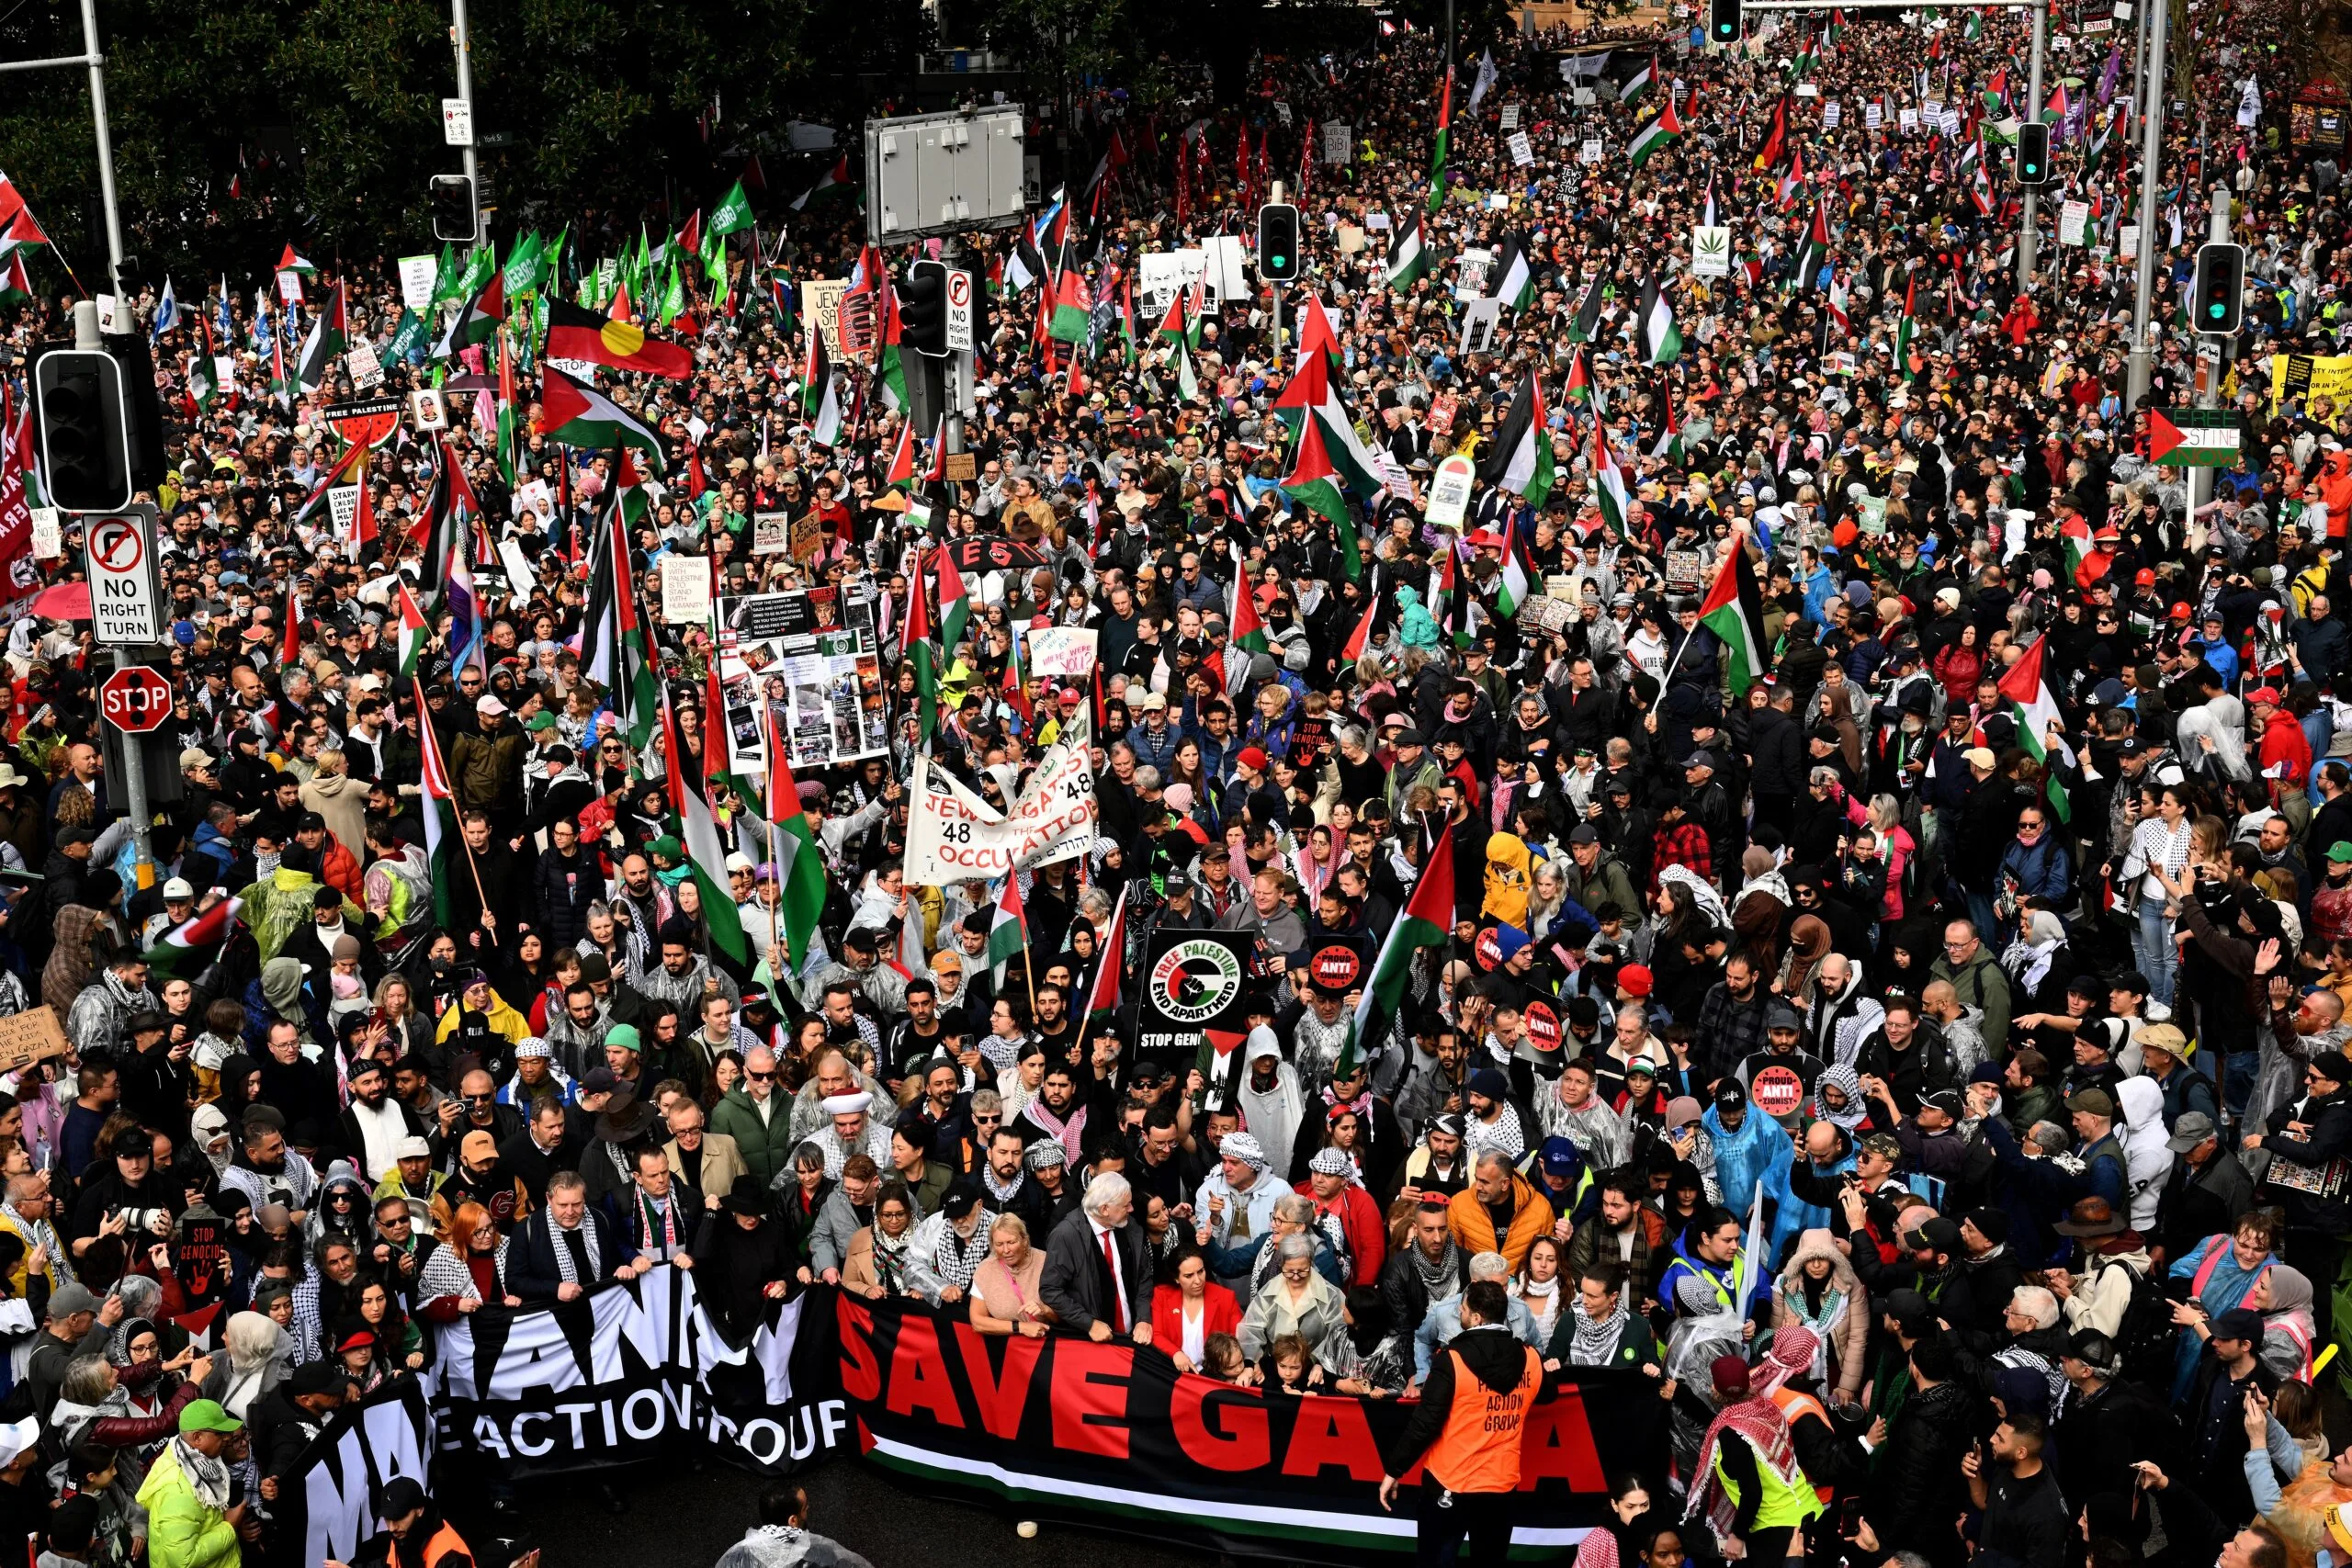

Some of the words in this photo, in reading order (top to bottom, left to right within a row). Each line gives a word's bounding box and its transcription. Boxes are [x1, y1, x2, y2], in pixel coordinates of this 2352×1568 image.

[483, 134, 496, 143] York
[1562, 167, 1582, 179] JEWS
[1561, 176, 1577, 186] SAY
[1558, 185, 1579, 194] STOP
[952, 309, 967, 322] NO
[948, 324, 969, 335] RIGHT
[950, 335, 969, 346] TURN
[361, 369, 375, 379] LAND
[555, 361, 587, 373] STOP
[362, 377, 379, 387] BACK
[325, 409, 348, 419] FREE
[351, 402, 398, 415] PALESTINE
[2173, 409, 2236, 428] FREE
[2176, 447, 2239, 465] NOW
[37, 526, 56, 537] NOT
[795, 515, 814, 537] JEWS
[103, 578, 137, 599] NO
[99, 603, 147, 617] RIGHT
[104, 621, 148, 636] TURN
[1032, 628, 1056, 651] HISTORY
[1042, 651, 1065, 666] WHERE
[1069, 644, 1092, 656] WERE
[1060, 651, 1092, 673] YOU?
[106, 685, 166, 714] STOP
[1303, 723, 1322, 734] STOP
[1291, 734, 1328, 745] GENOCIDE
[1154, 950, 1183, 980] FREE
[1183, 942, 1238, 979] PALESTINE
[1321, 954, 1351, 963] PROUD
[1319, 962, 1351, 974] ANTI
[1152, 981, 1171, 1009] END
[1167, 981, 1236, 1020] APARTHEID
[5, 1017, 20, 1027] ARE
[24, 1010, 46, 1020] THE
[1530, 1009, 1553, 1024] PROUD
[20, 1021, 39, 1031] FOR
[1530, 1018, 1555, 1037] ANTI
[18, 1031, 43, 1042] KIDS
[1141, 1032, 1172, 1047] STOP
[1530, 1028, 1555, 1043] ZIONIST
[1, 1048, 15, 1059] IN
[18, 1037, 51, 1054] GAZA!
[1762, 1076, 1792, 1086] PROUD
[1761, 1085, 1793, 1098] ANTI
[1762, 1097, 1793, 1105] ZIONIST
[193, 1227, 215, 1243] STOP
[836, 1290, 1136, 1461] SAVE
[1169, 1372, 1610, 1494] GAA
[1487, 1393, 1524, 1414] ACTION
[472, 1378, 693, 1460] ACTION
[1484, 1415, 1521, 1433] GROUP
[150, 1437, 170, 1452] has
